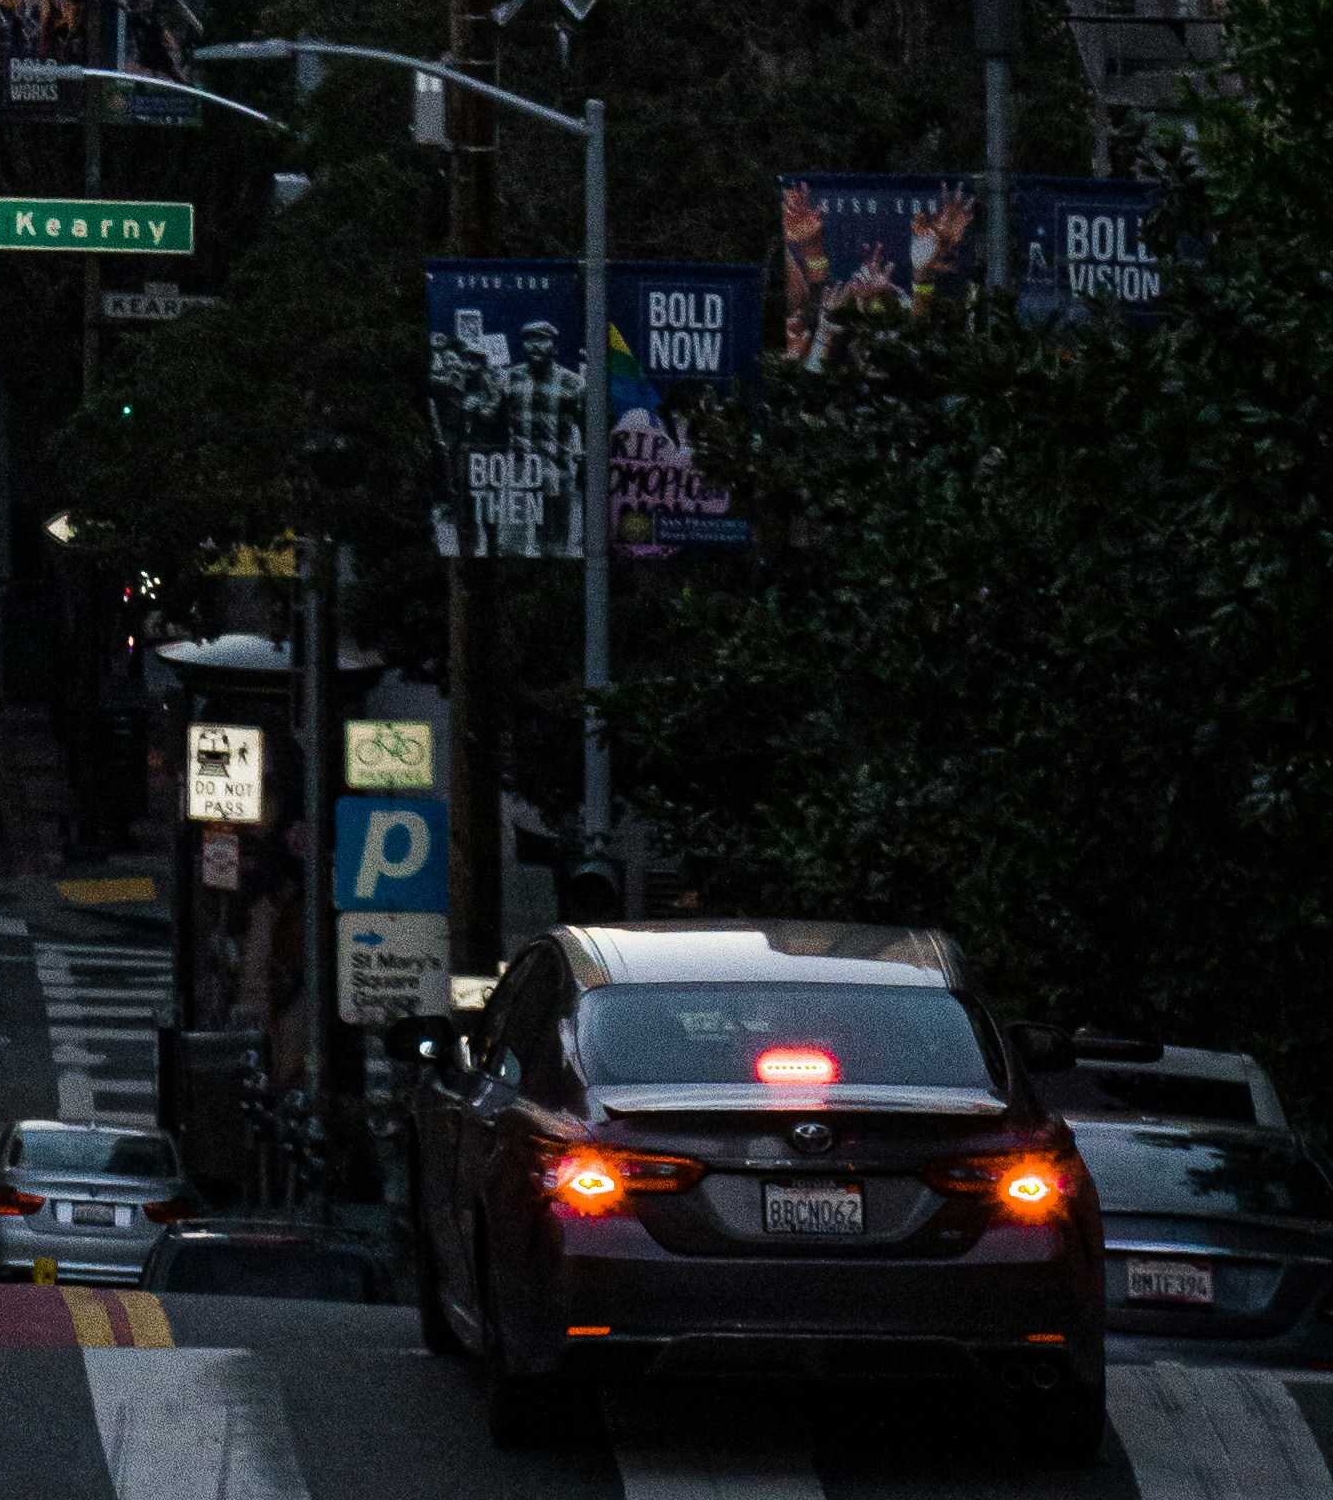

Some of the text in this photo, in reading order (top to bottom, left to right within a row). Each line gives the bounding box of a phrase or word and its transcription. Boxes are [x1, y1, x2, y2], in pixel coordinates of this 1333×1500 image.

[9, 83, 59, 102] WORKS
[15, 210, 167, 246] Kearny
[1068, 263, 1161, 302] VISION
[648, 290, 724, 329] BOLD
[648, 330, 723, 372] NOW
[469, 452, 544, 489] BOLD
[468, 490, 545, 526] THEN
[195, 782, 253, 798] DO NOT
[204, 801, 244, 815] PASS
[770, 1199, 859, 1225] 8BCN062
